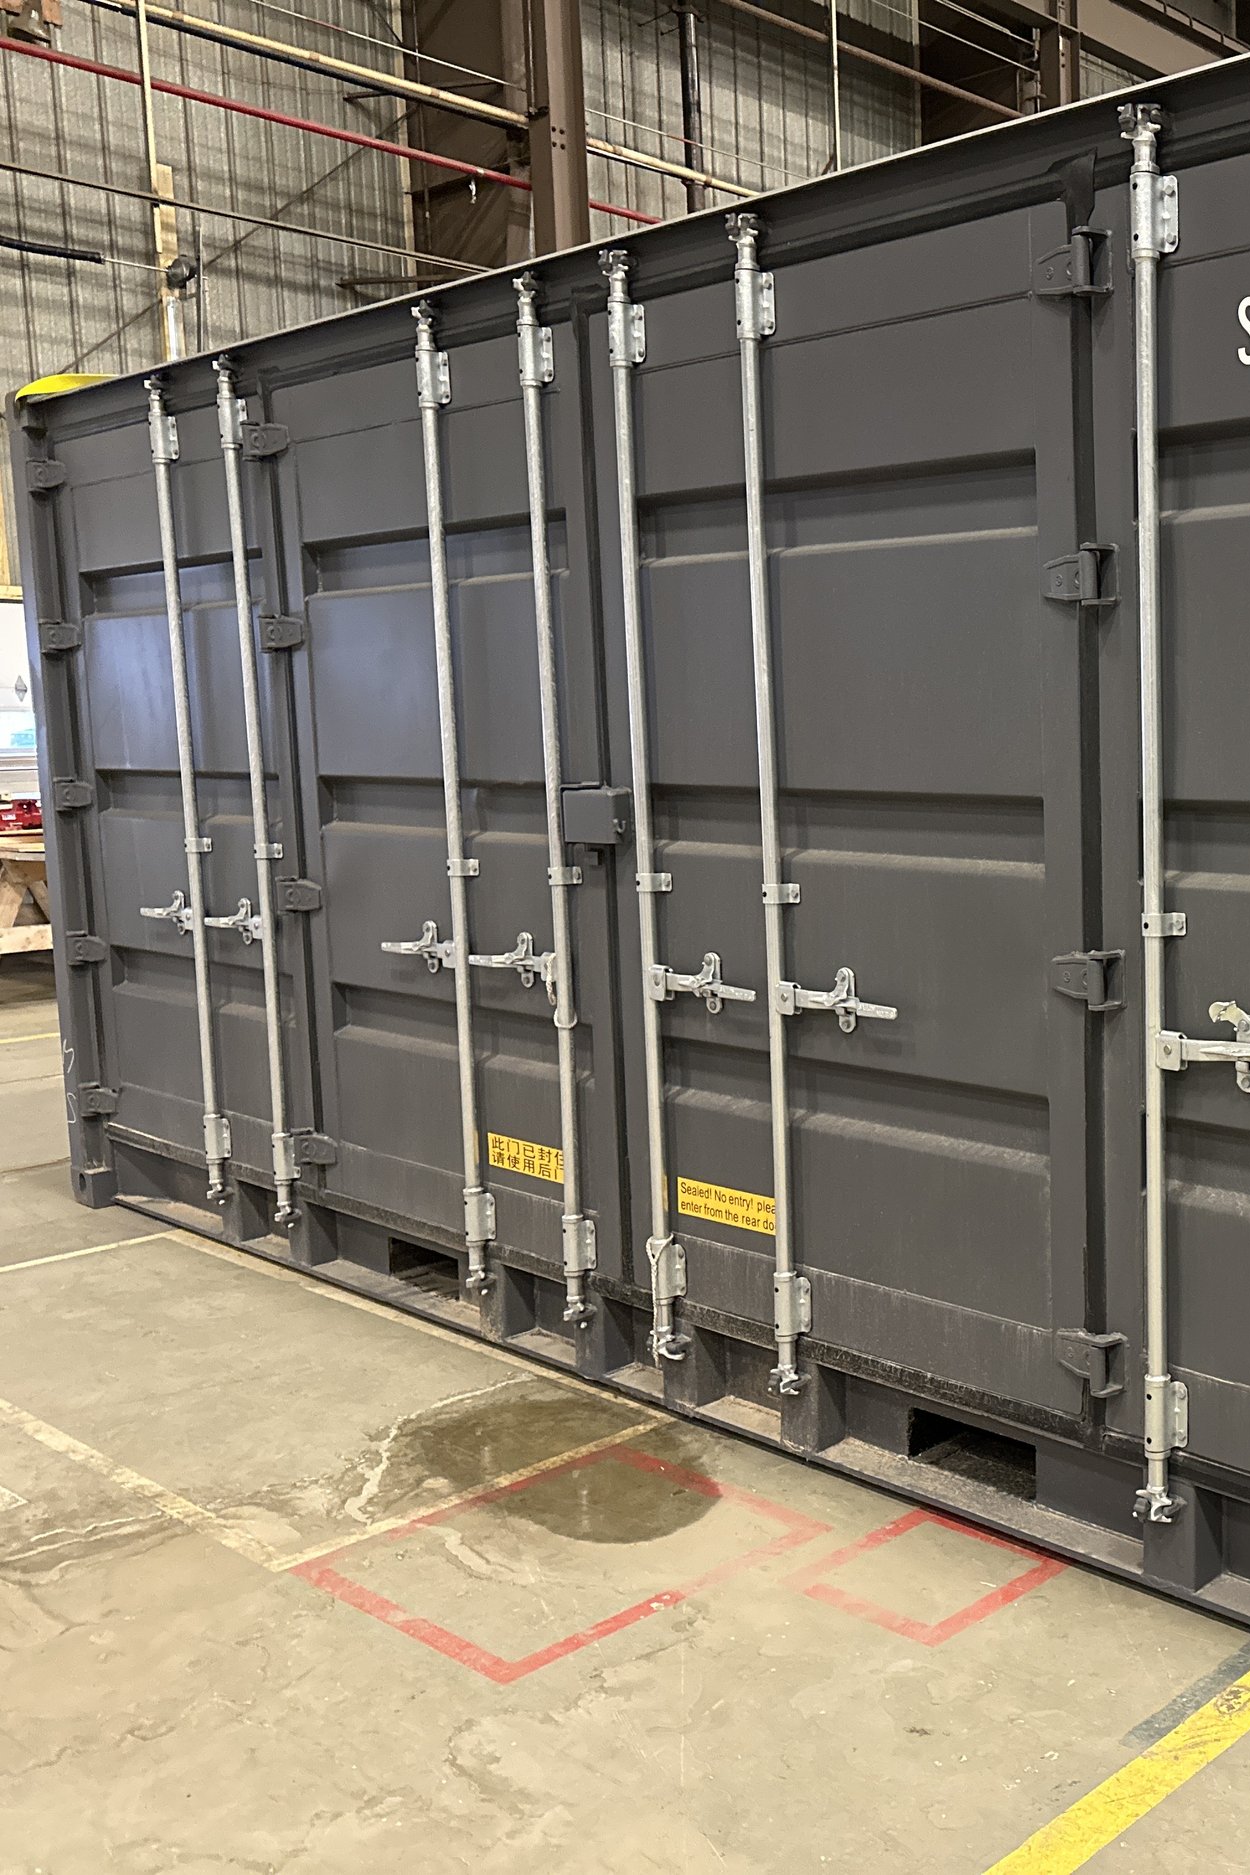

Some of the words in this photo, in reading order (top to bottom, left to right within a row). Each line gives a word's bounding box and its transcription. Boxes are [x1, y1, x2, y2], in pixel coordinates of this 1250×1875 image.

[680, 1182, 712, 1200] Sealed!
[714, 1189, 727, 1204] No
[728, 1195, 754, 1212] entry!
[680, 1200, 703, 1213] enter
[703, 1203, 723, 1218] from
[724, 1209, 739, 1223] the
[741, 1214, 761, 1228] rear
[762, 1219, 777, 1231] do
